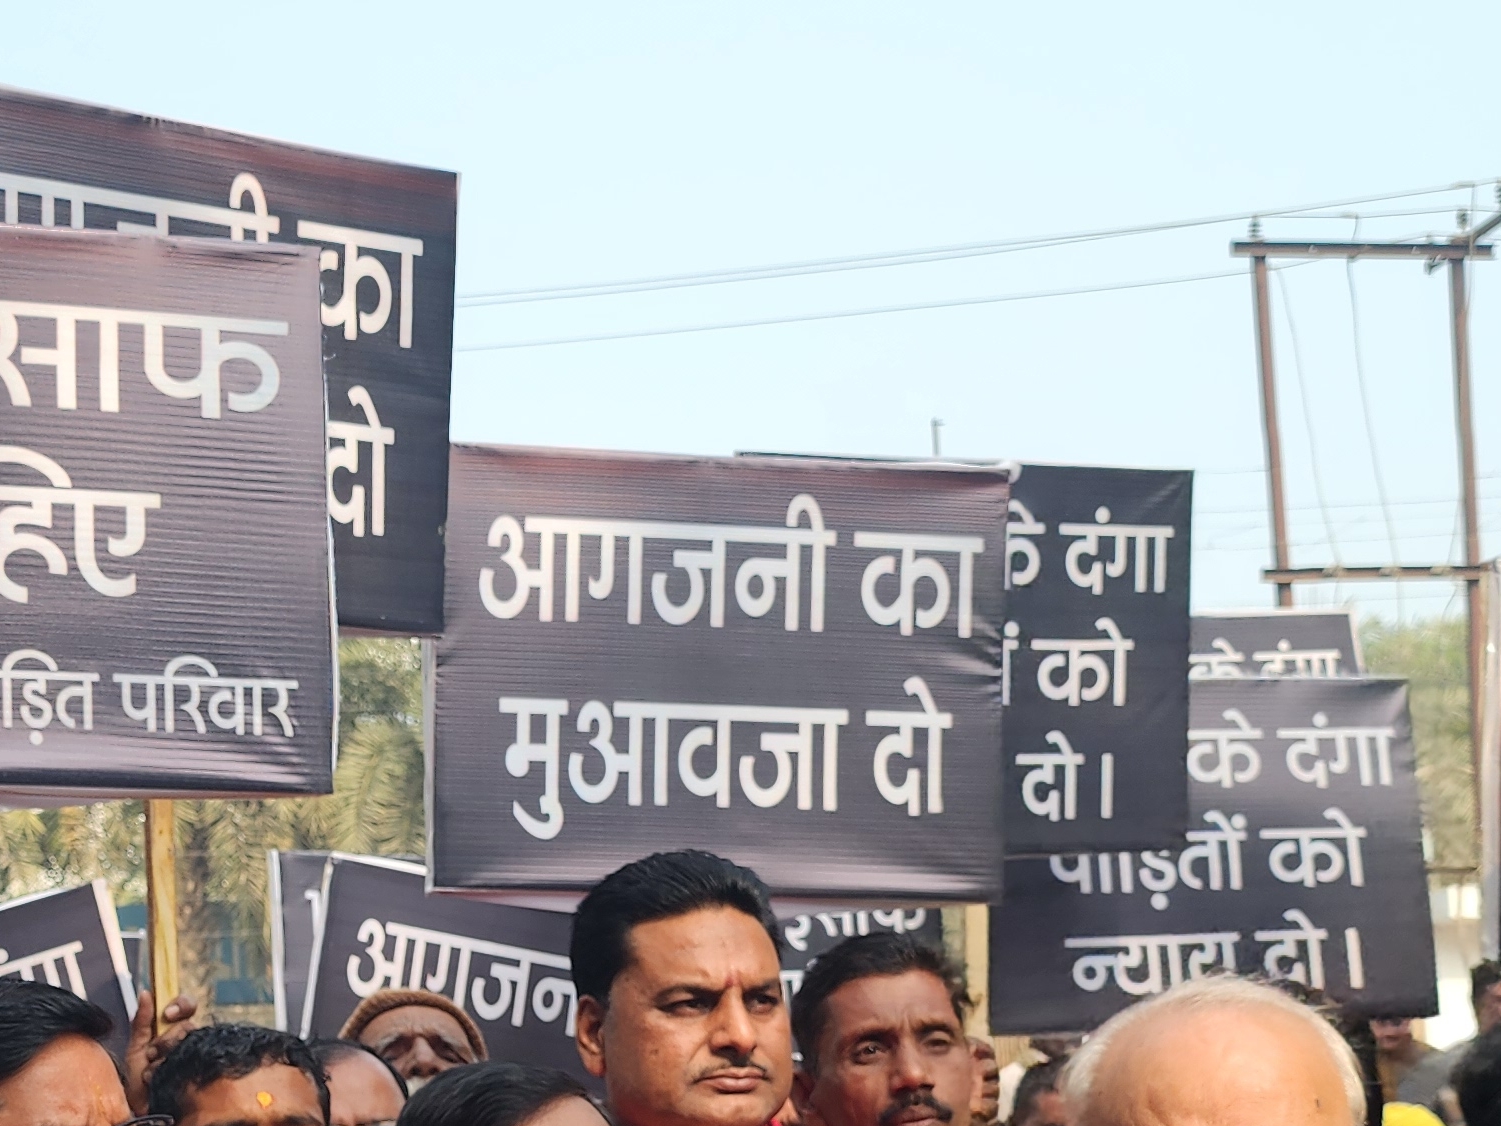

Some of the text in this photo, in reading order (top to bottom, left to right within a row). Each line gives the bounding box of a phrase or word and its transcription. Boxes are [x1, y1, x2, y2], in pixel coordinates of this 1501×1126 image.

[479, 493, 986, 639] आगजनी का
[1058, 506, 1175, 595] दंगा
[113, 655, 299, 738] परिवार
[1030, 616, 1135, 707] को
[499, 676, 953, 841] मुआवजा दो
[1187, 708, 1396, 789] के दंगा
[1259, 807, 1368, 888] को
[347, 917, 578, 1037] आगजन
